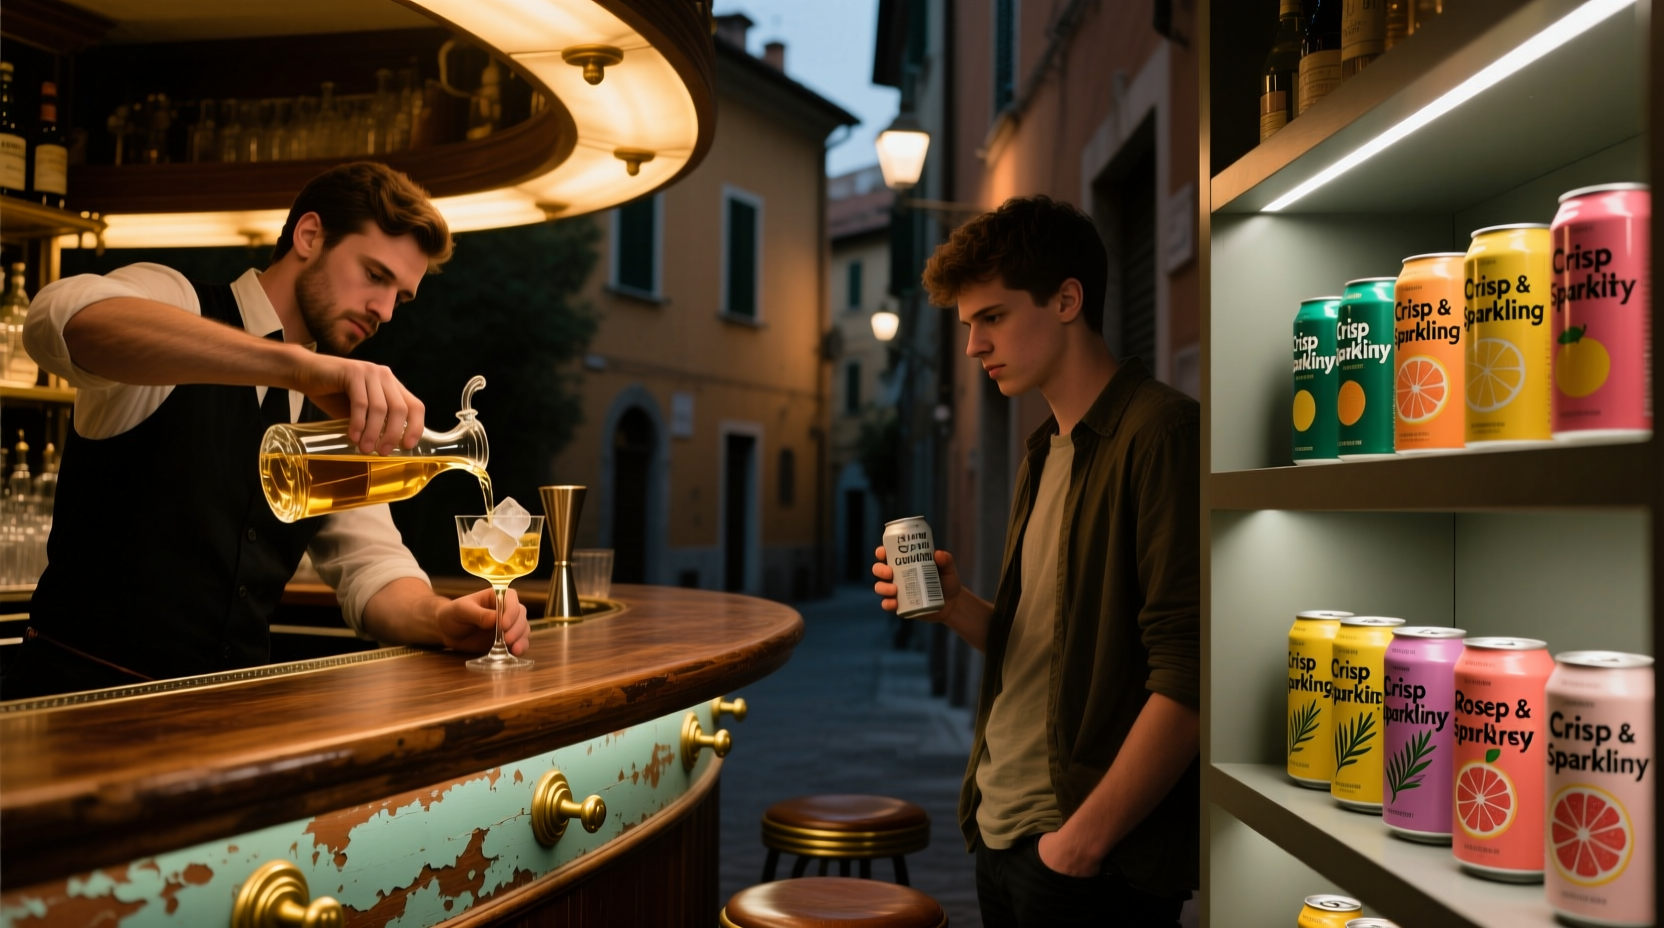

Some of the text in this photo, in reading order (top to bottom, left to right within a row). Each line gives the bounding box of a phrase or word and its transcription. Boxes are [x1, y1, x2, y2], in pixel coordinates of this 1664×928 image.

[1553, 244, 1612, 275] Crisp
[1465, 275, 1531, 300] Crisp &
[1395, 299, 1451, 321] Crisp &
[1464, 299, 1545, 333] Sparkling
[1337, 318, 1369, 343] Crisp
[1331, 658, 1370, 684] Crisp
[1384, 675, 1426, 704] Crisp
[1455, 690, 1531, 723] Rosep &
[1549, 711, 1636, 746] Crisp &
[1547, 743, 1650, 782] Sparkliny
